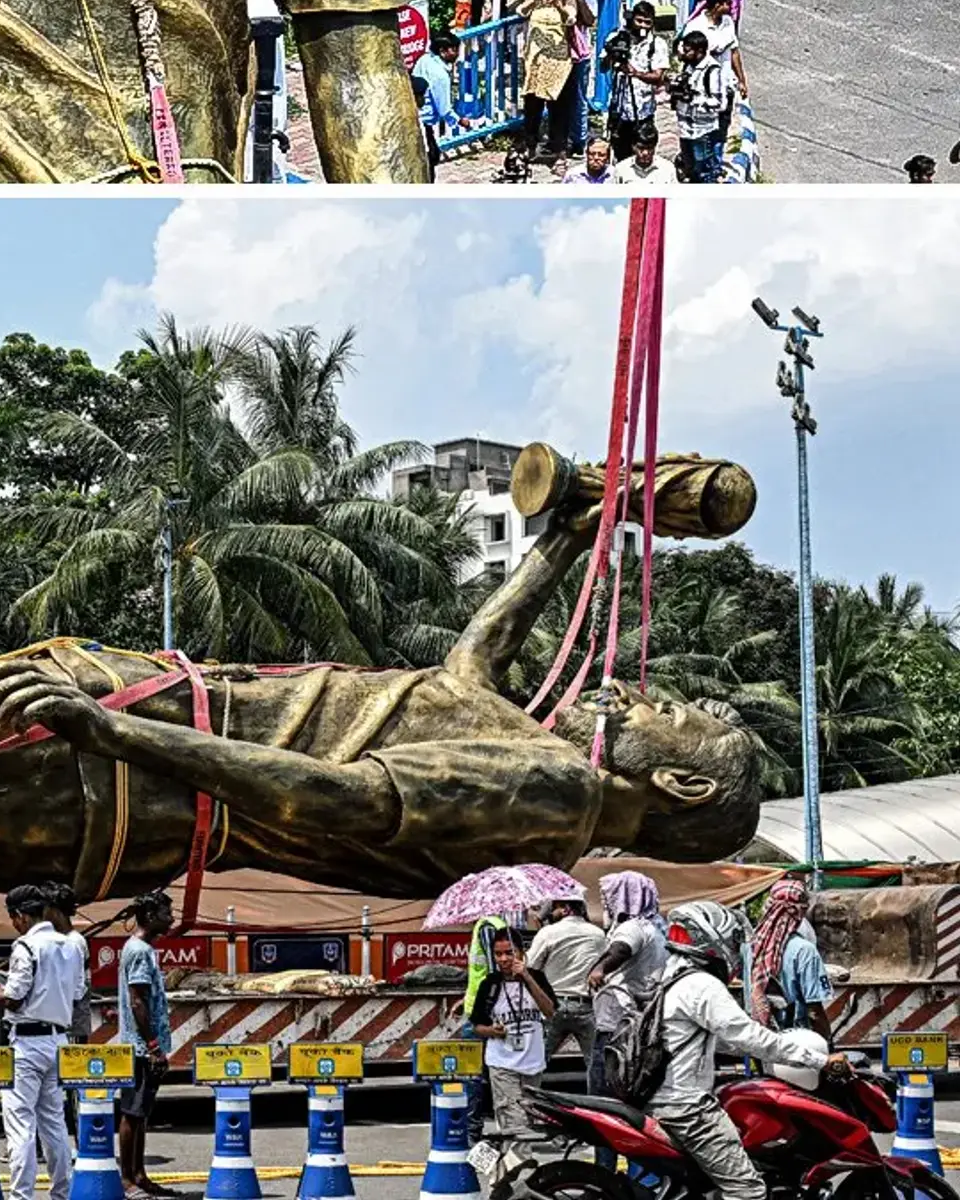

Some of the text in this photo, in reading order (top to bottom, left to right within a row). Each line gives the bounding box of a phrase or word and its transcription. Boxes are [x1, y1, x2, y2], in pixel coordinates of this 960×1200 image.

[407, 943, 469, 958] PRITAM
[890, 1036, 944, 1044] UCO BANK
